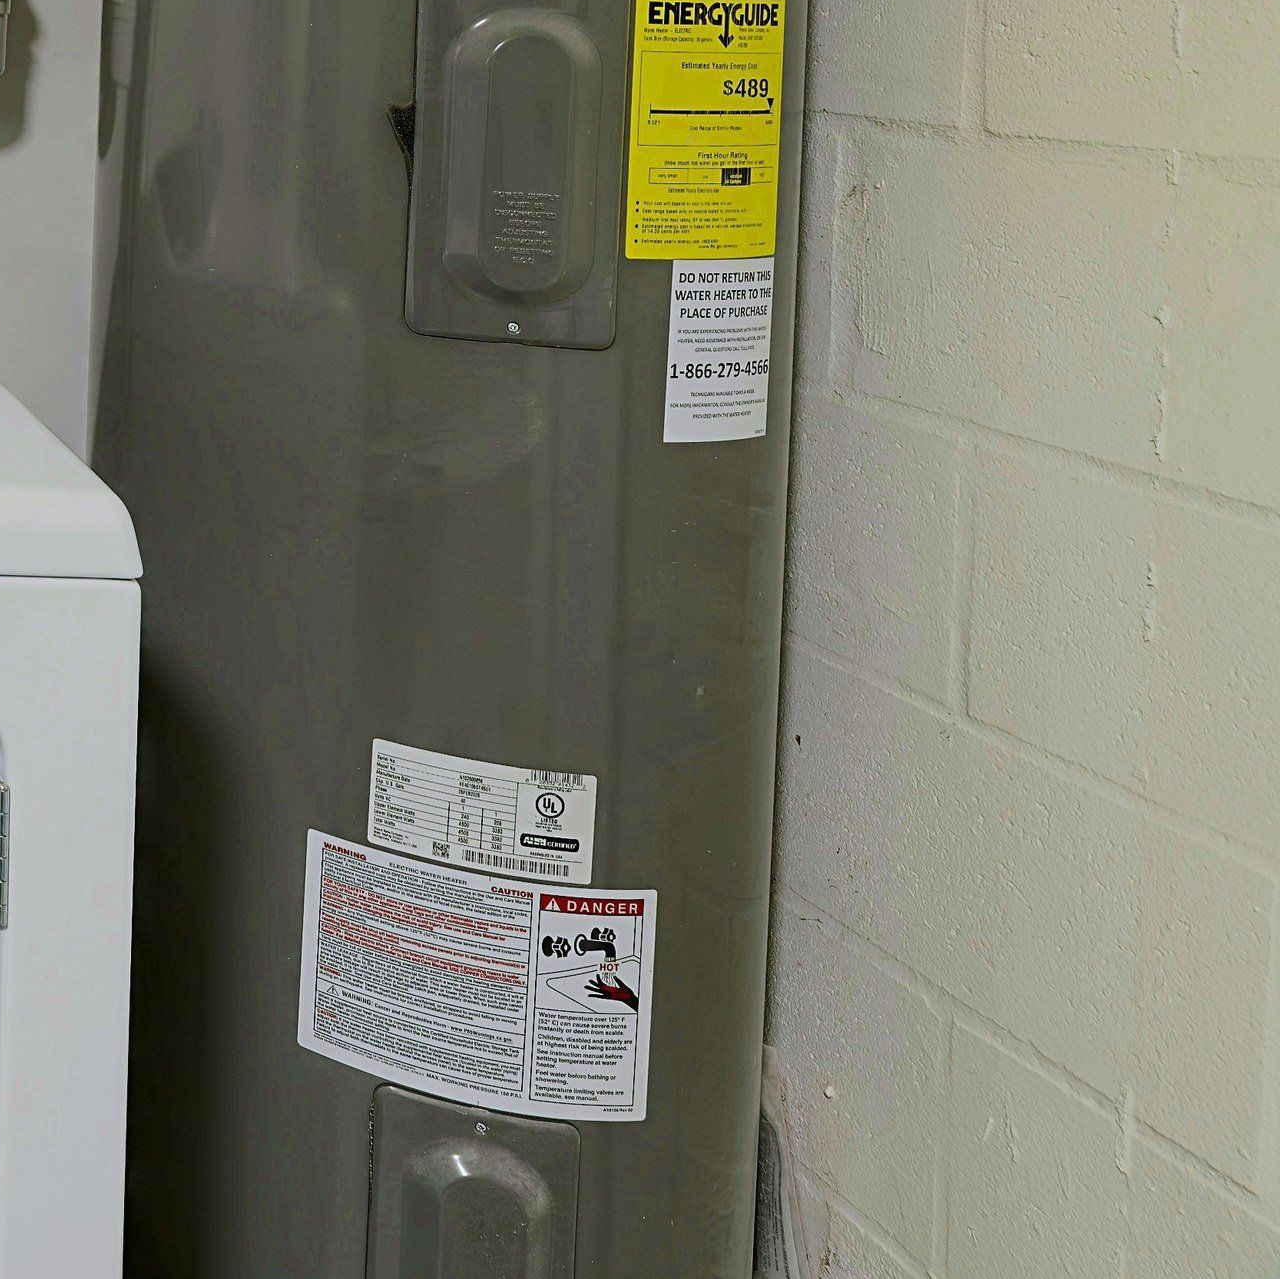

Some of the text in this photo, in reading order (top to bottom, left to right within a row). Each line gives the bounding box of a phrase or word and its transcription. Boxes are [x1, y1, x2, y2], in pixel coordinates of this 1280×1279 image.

[648, 1, 779, 26] ENERGYGUIDE
[723, 78, 769, 98] $489
[730, 152, 748, 160] Rating
[679, 270, 771, 283] DO NOT RETURN THIS
[675, 287, 771, 301] WATER HEATER TO THE
[680, 305, 768, 318] PLACE OF PURCHASE
[670, 359, 769, 379] 1-866-279-4566
[387, 805, 403, 813] Element
[543, 797, 557, 813] UL
[323, 841, 367, 861] WARNING
[389, 862, 467, 885] ELECTRIC WATER HEATER
[490, 886, 534, 898] CAUTION
[567, 900, 638, 915] DANGER
[599, 963, 620, 972] HOT
[341, 990, 374, 1008] WARNING:
